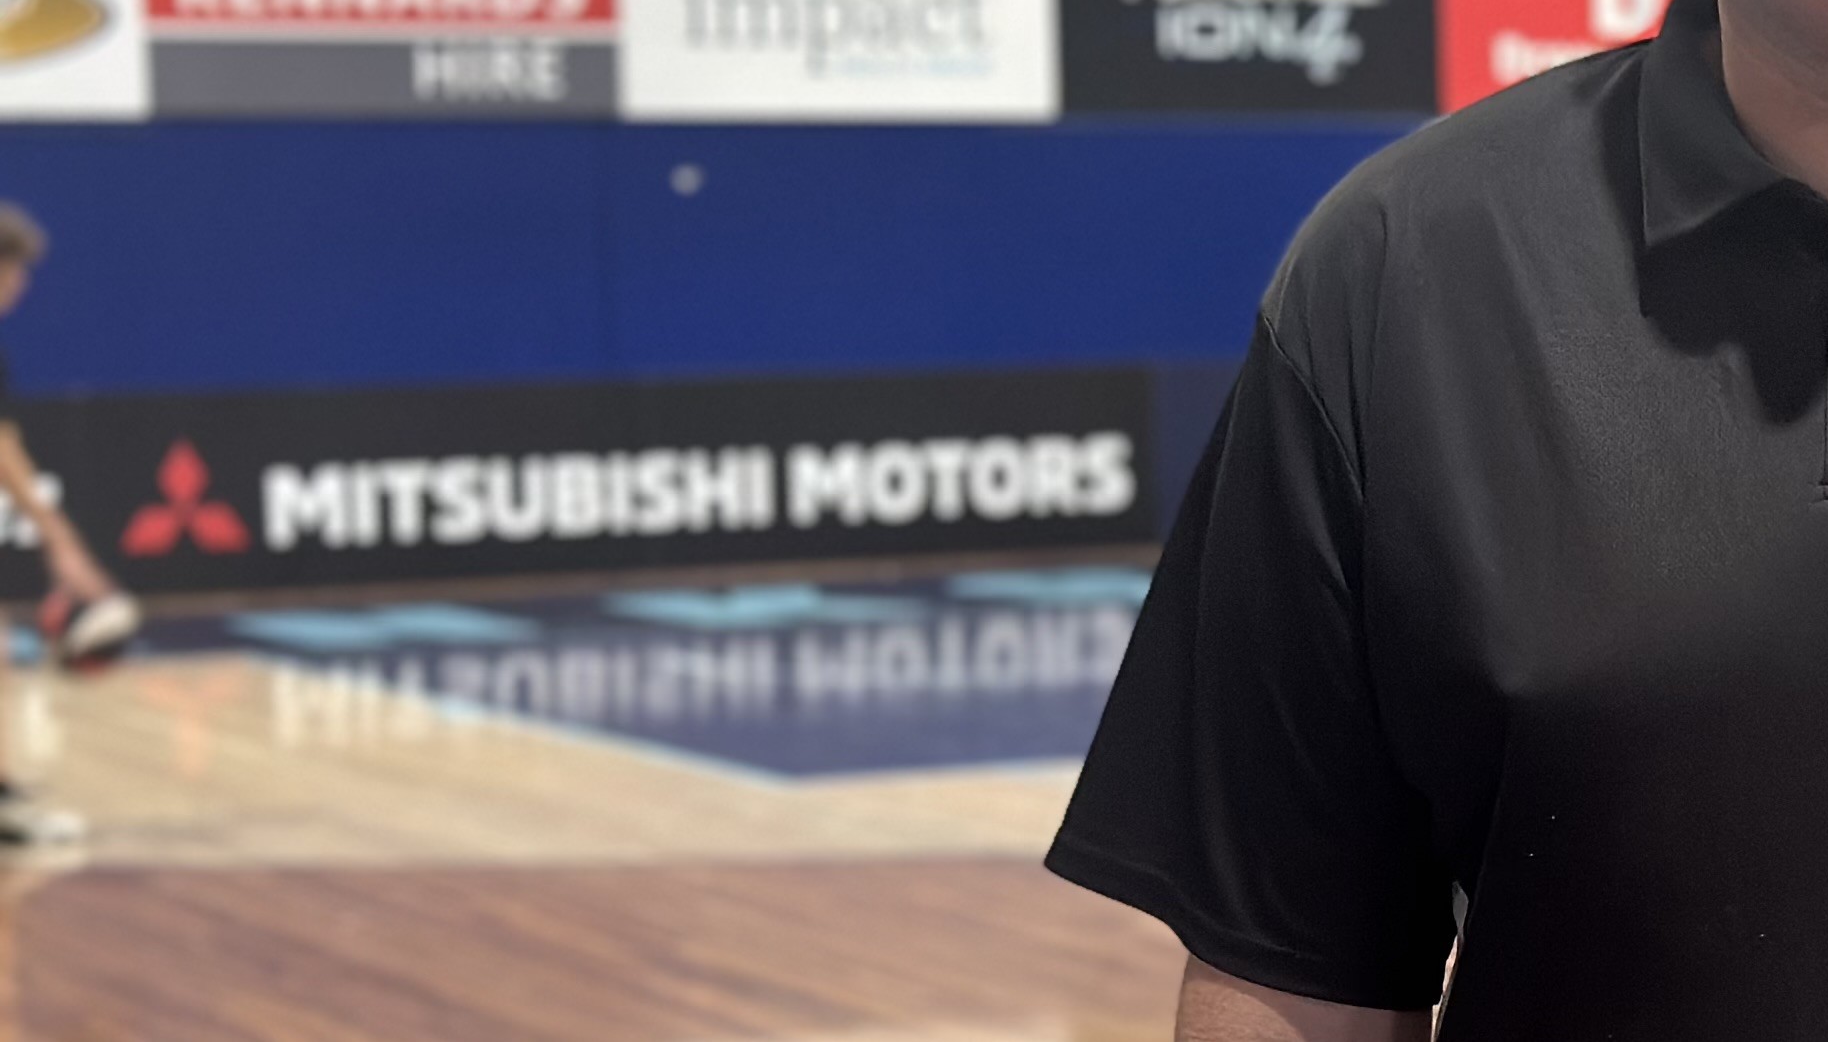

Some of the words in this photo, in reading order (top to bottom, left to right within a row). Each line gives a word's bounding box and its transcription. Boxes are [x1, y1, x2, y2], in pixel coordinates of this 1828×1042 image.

[411, 38, 566, 101] HIRE
[262, 445, 775, 551] MITSUBISHI
[787, 432, 1137, 528] MOTORS
